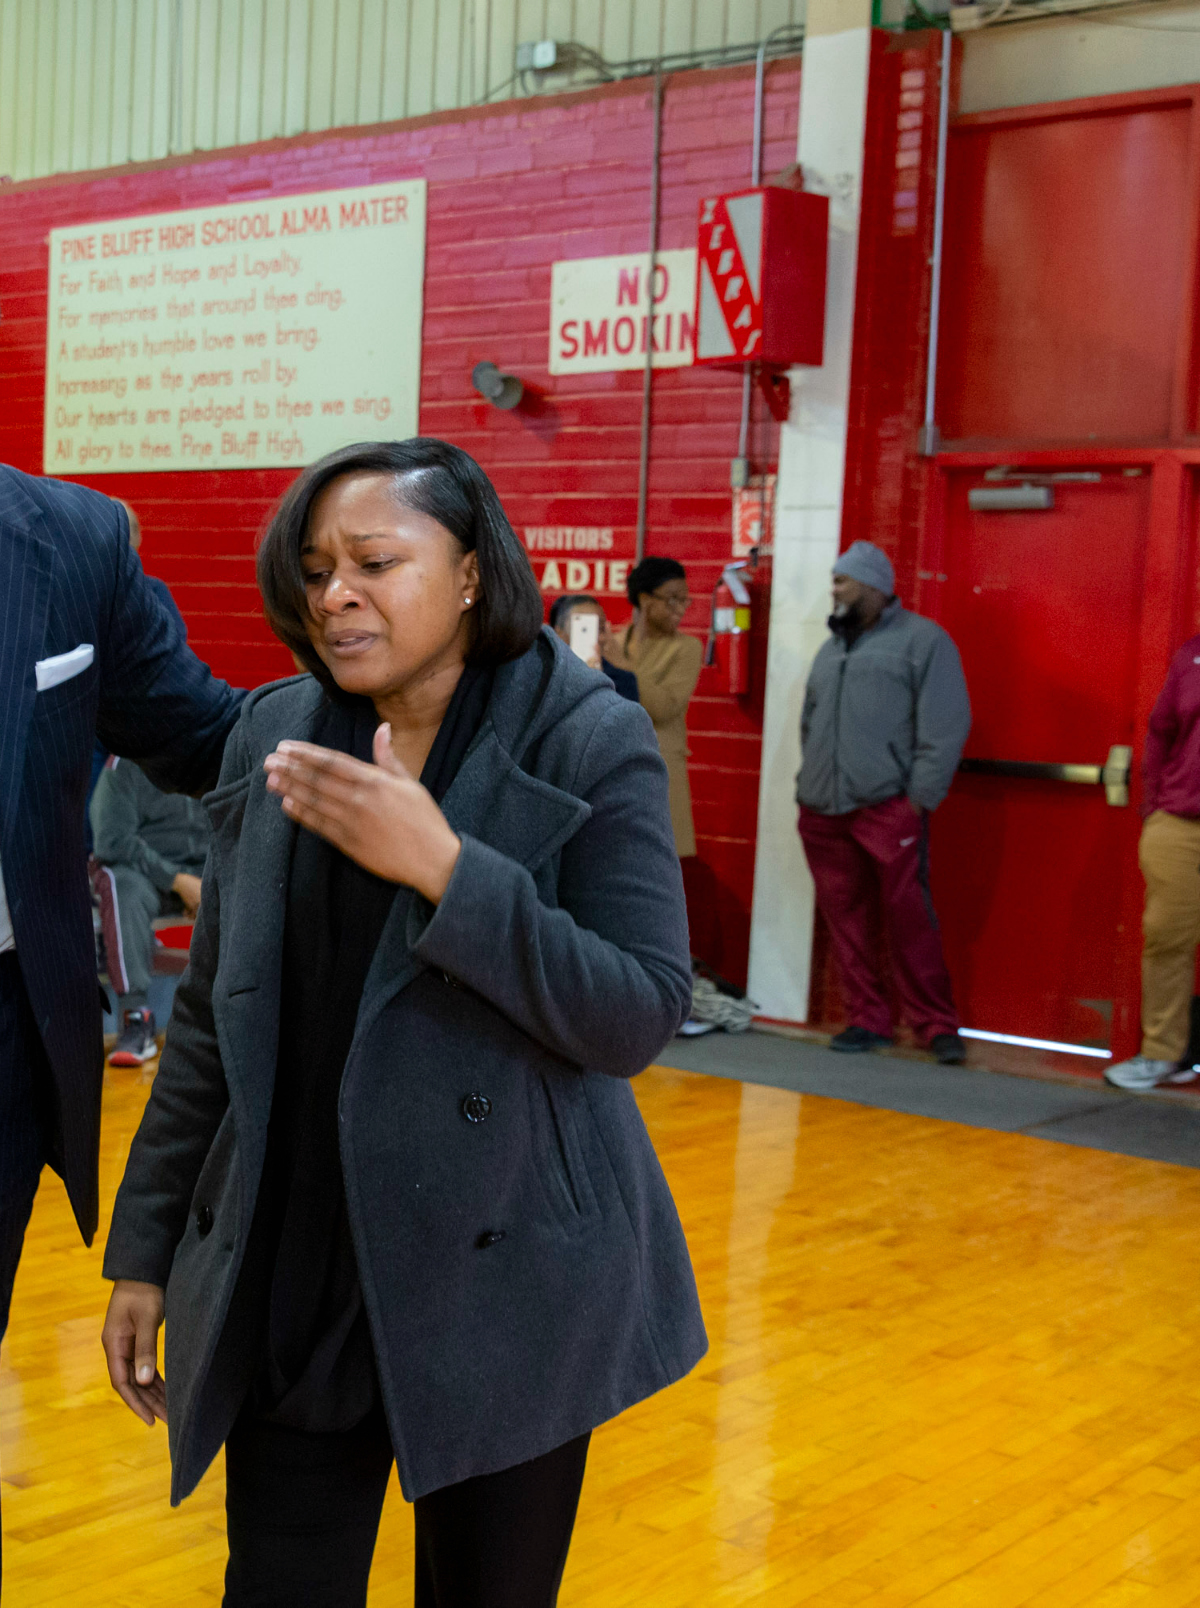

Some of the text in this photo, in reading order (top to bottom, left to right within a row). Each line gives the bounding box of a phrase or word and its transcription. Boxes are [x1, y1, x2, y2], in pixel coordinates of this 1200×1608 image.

[60, 194, 410, 263] PINE BLUFF HIGH SCHOOL ALMA MATER
[58, 273, 83, 297] For
[88, 269, 124, 295] Faith
[128, 264, 157, 291] and
[161, 262, 201, 290] Hope
[207, 253, 238, 286] and
[616, 263, 670, 307] NO
[700, 199, 763, 357] ZEBRAS
[57, 305, 83, 330] For
[88, 301, 158, 332] memories
[166, 295, 196, 323] that
[201, 287, 257, 318] around
[262, 284, 299, 314] thee
[58, 340, 70, 362] A
[72, 336, 139, 364] student's
[142, 329, 198, 360] humble
[201, 327, 236, 352] love
[242, 330, 268, 348] we
[560, 312, 694, 360] SMOKIN
[55, 370, 128, 399] Increasing
[134, 374, 153, 391] as
[160, 365, 184, 393] the
[187, 369, 234, 394] years
[241, 358, 271, 385] roll
[54, 405, 83, 429] Our
[87, 403, 138, 432] hearts
[145, 407, 172, 425] are
[253, 399, 271, 420] to
[275, 394, 314, 425] thee
[321, 399, 346, 416] we
[55, 437, 73, 461] All
[77, 437, 114, 466] glory
[118, 439, 134, 459] to
[180, 432, 213, 462] Pine
[220, 430, 259, 460] Bluff
[524, 526, 614, 551] VISITORS
[541, 560, 629, 592] ADIE
